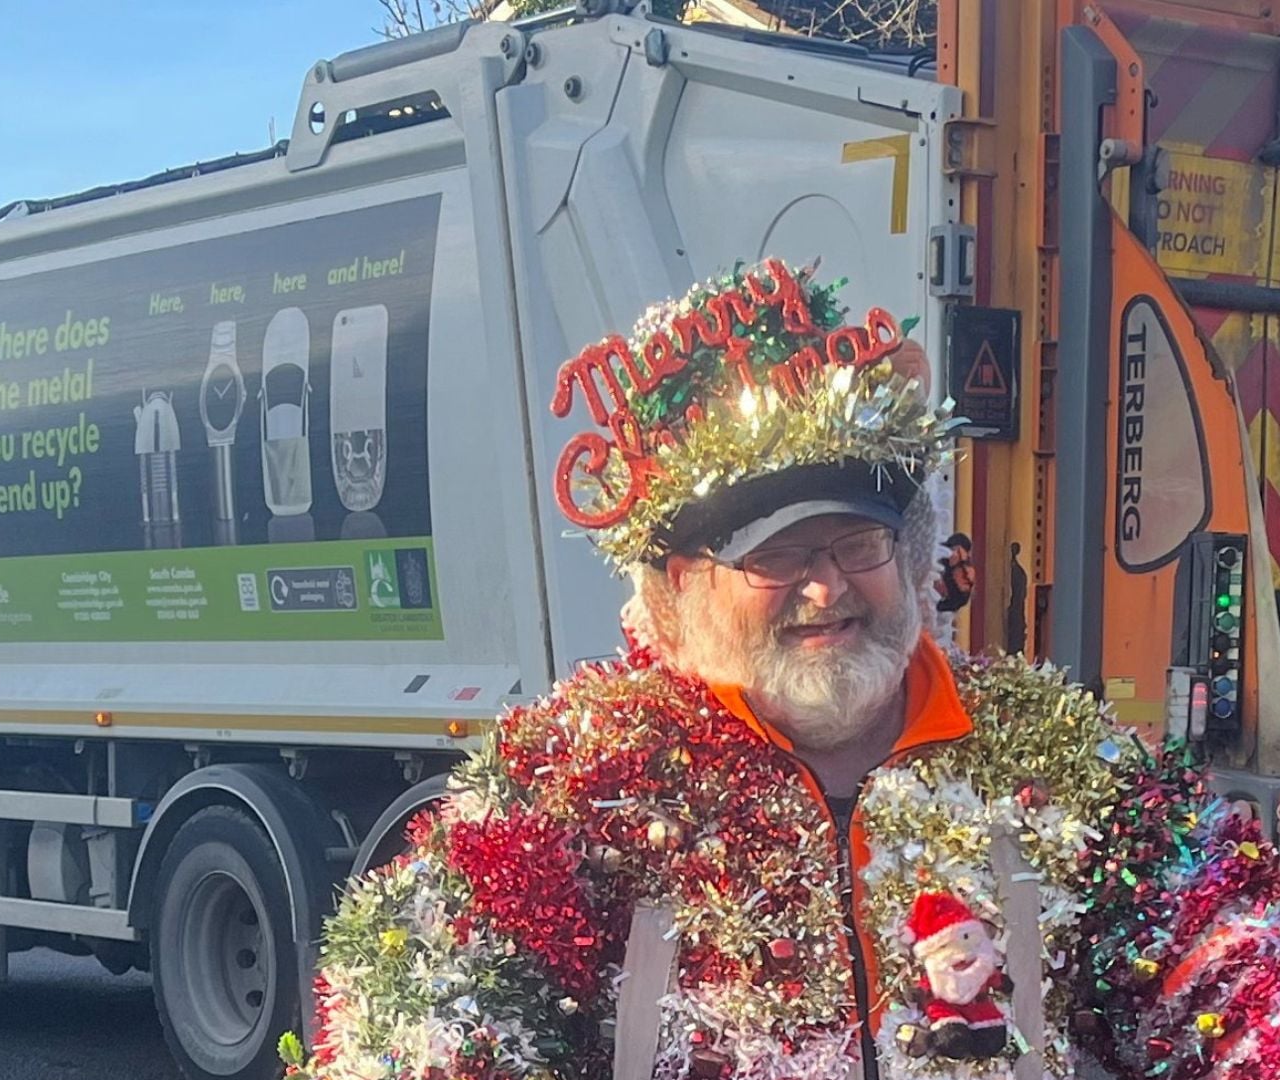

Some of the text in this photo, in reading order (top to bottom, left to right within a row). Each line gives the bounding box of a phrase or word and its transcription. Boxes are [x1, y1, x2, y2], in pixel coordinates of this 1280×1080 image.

[1177, 200, 1216, 225] NOT
[148, 249, 405, 316] Here, here, here and here!
[55, 309, 110, 352] does
[550, 258, 815, 428] Merry
[27, 358, 94, 407] metal
[21, 411, 100, 467] recycle
[1122, 321, 1148, 542] TERBERG
[41, 466, 82, 519] up?
